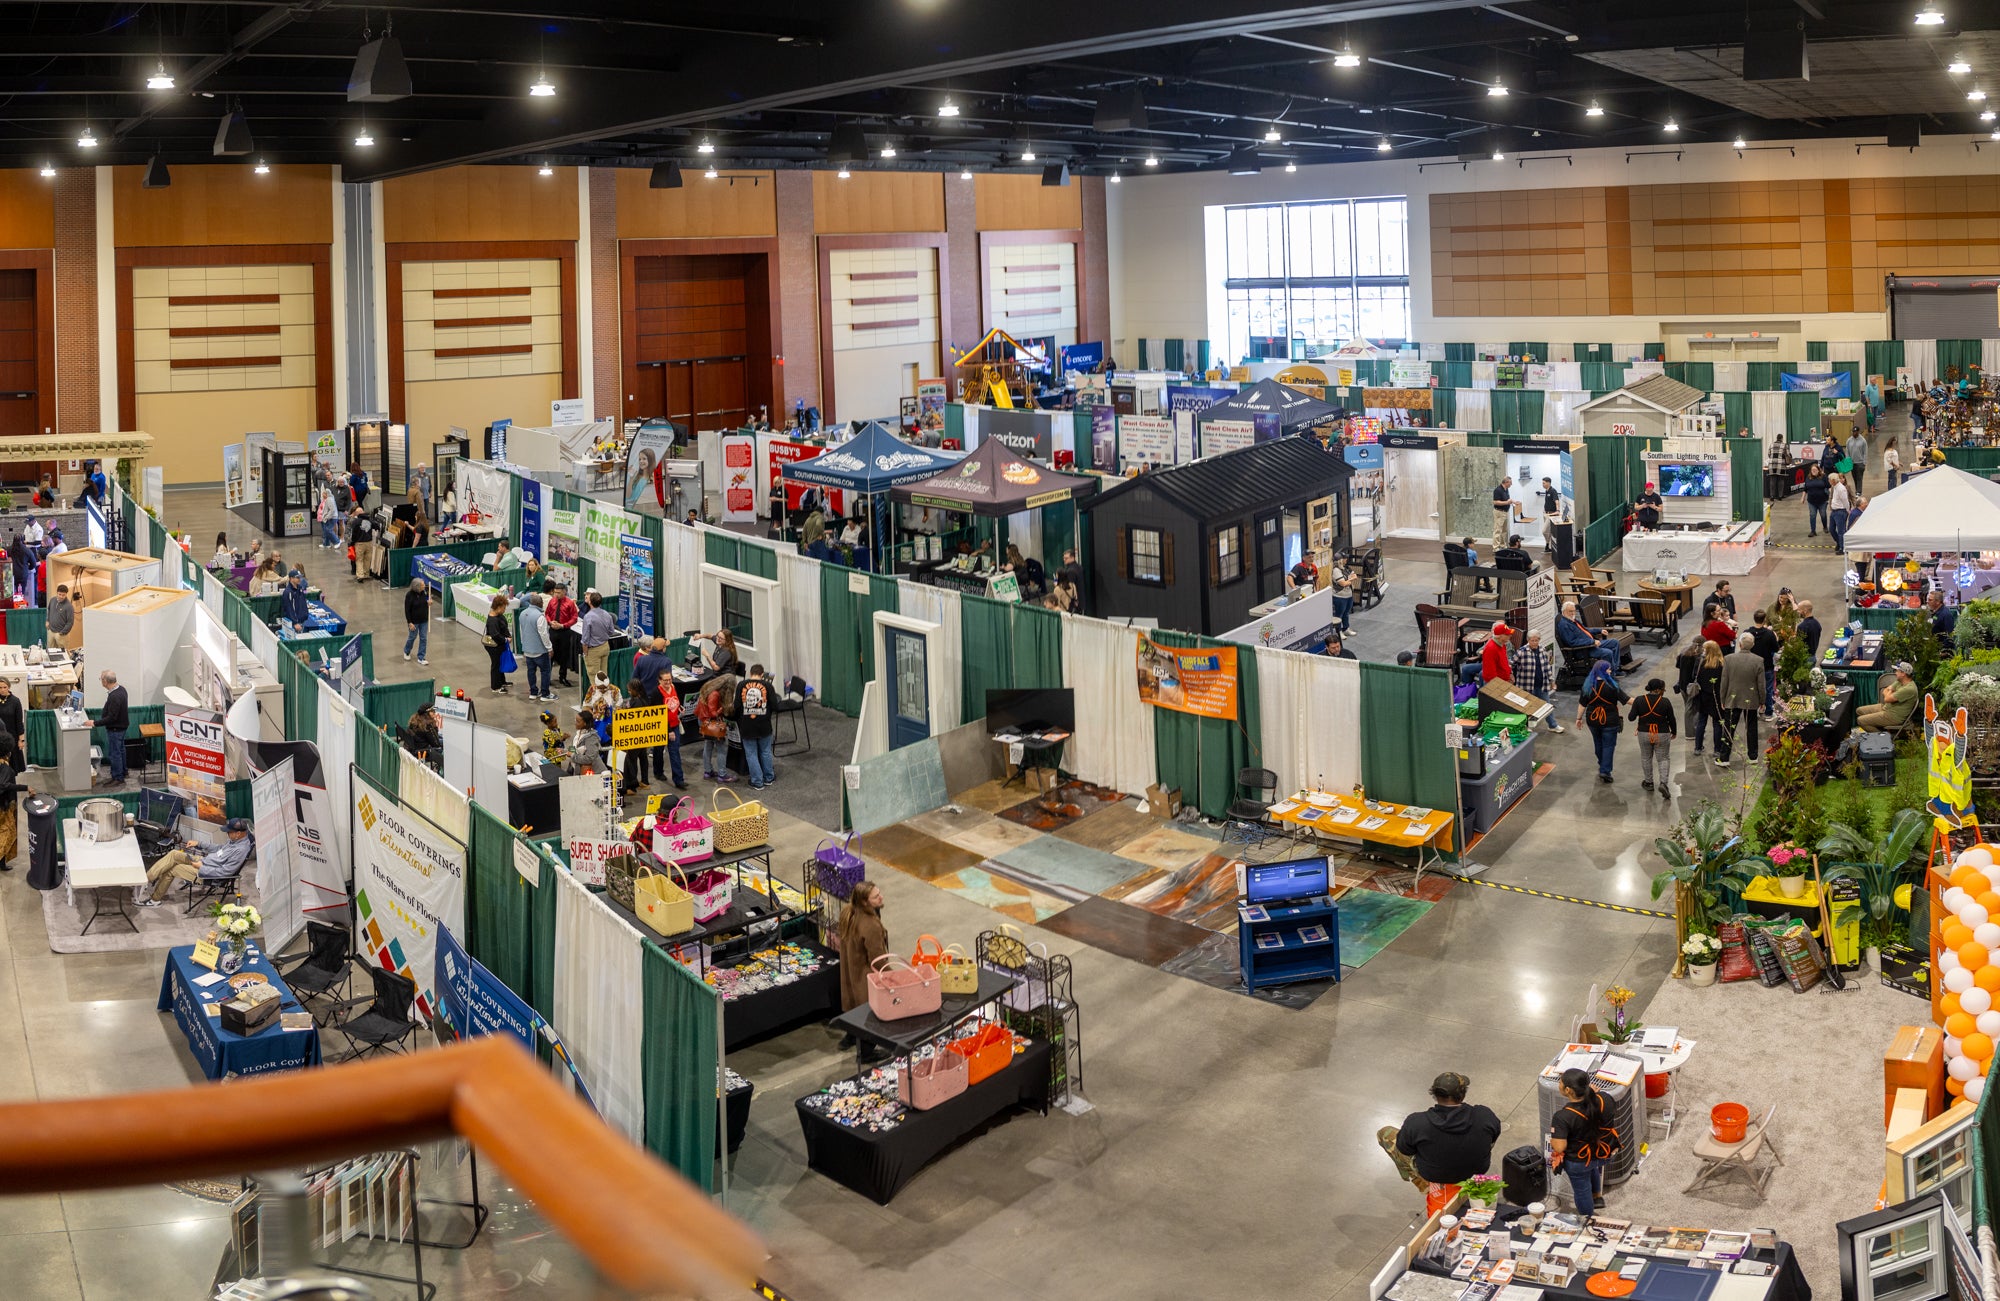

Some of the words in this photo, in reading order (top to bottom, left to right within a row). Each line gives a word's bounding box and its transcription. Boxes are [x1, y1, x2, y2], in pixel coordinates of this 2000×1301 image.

[1072, 355, 1092, 364] encore
[1172, 399, 1212, 408] WINDOW
[1297, 422, 1310, 431] THAT
[1314, 414, 1335, 426] PAINTER
[1613, 425, 1635, 435] 20%
[317, 447, 342, 455] OSEY
[769, 444, 800, 458] BUSBY'S
[554, 517, 574, 525] maids
[555, 511, 576, 520] merry
[587, 508, 639, 534] merry
[1530, 584, 1551, 600] FISHER
[1270, 626, 1296, 644] PEACHTREE
[615, 707, 666, 720] INSTANT
[180, 720, 221, 740] CNT
[619, 721, 661, 734] HEADLIGHT
[615, 734, 666, 748] RESTORATION
[184, 750, 206, 760] NOTICING
[192, 759, 204, 767] THESE
[1502, 771, 1528, 798] PEACHTREE
[379, 810, 405, 839] FLOOR
[408, 833, 461, 879] COVERINGS
[570, 841, 593, 860] SUPER
[379, 828, 435, 878] international
[371, 863, 385, 881] The
[386, 876, 405, 899] Stars
[407, 897, 415, 907] of
[416, 901, 440, 925] Floor
[458, 967, 479, 995] FLOOR
[482, 992, 526, 1037] COVERINGS
[243, 1061, 276, 1074] FLOOR
